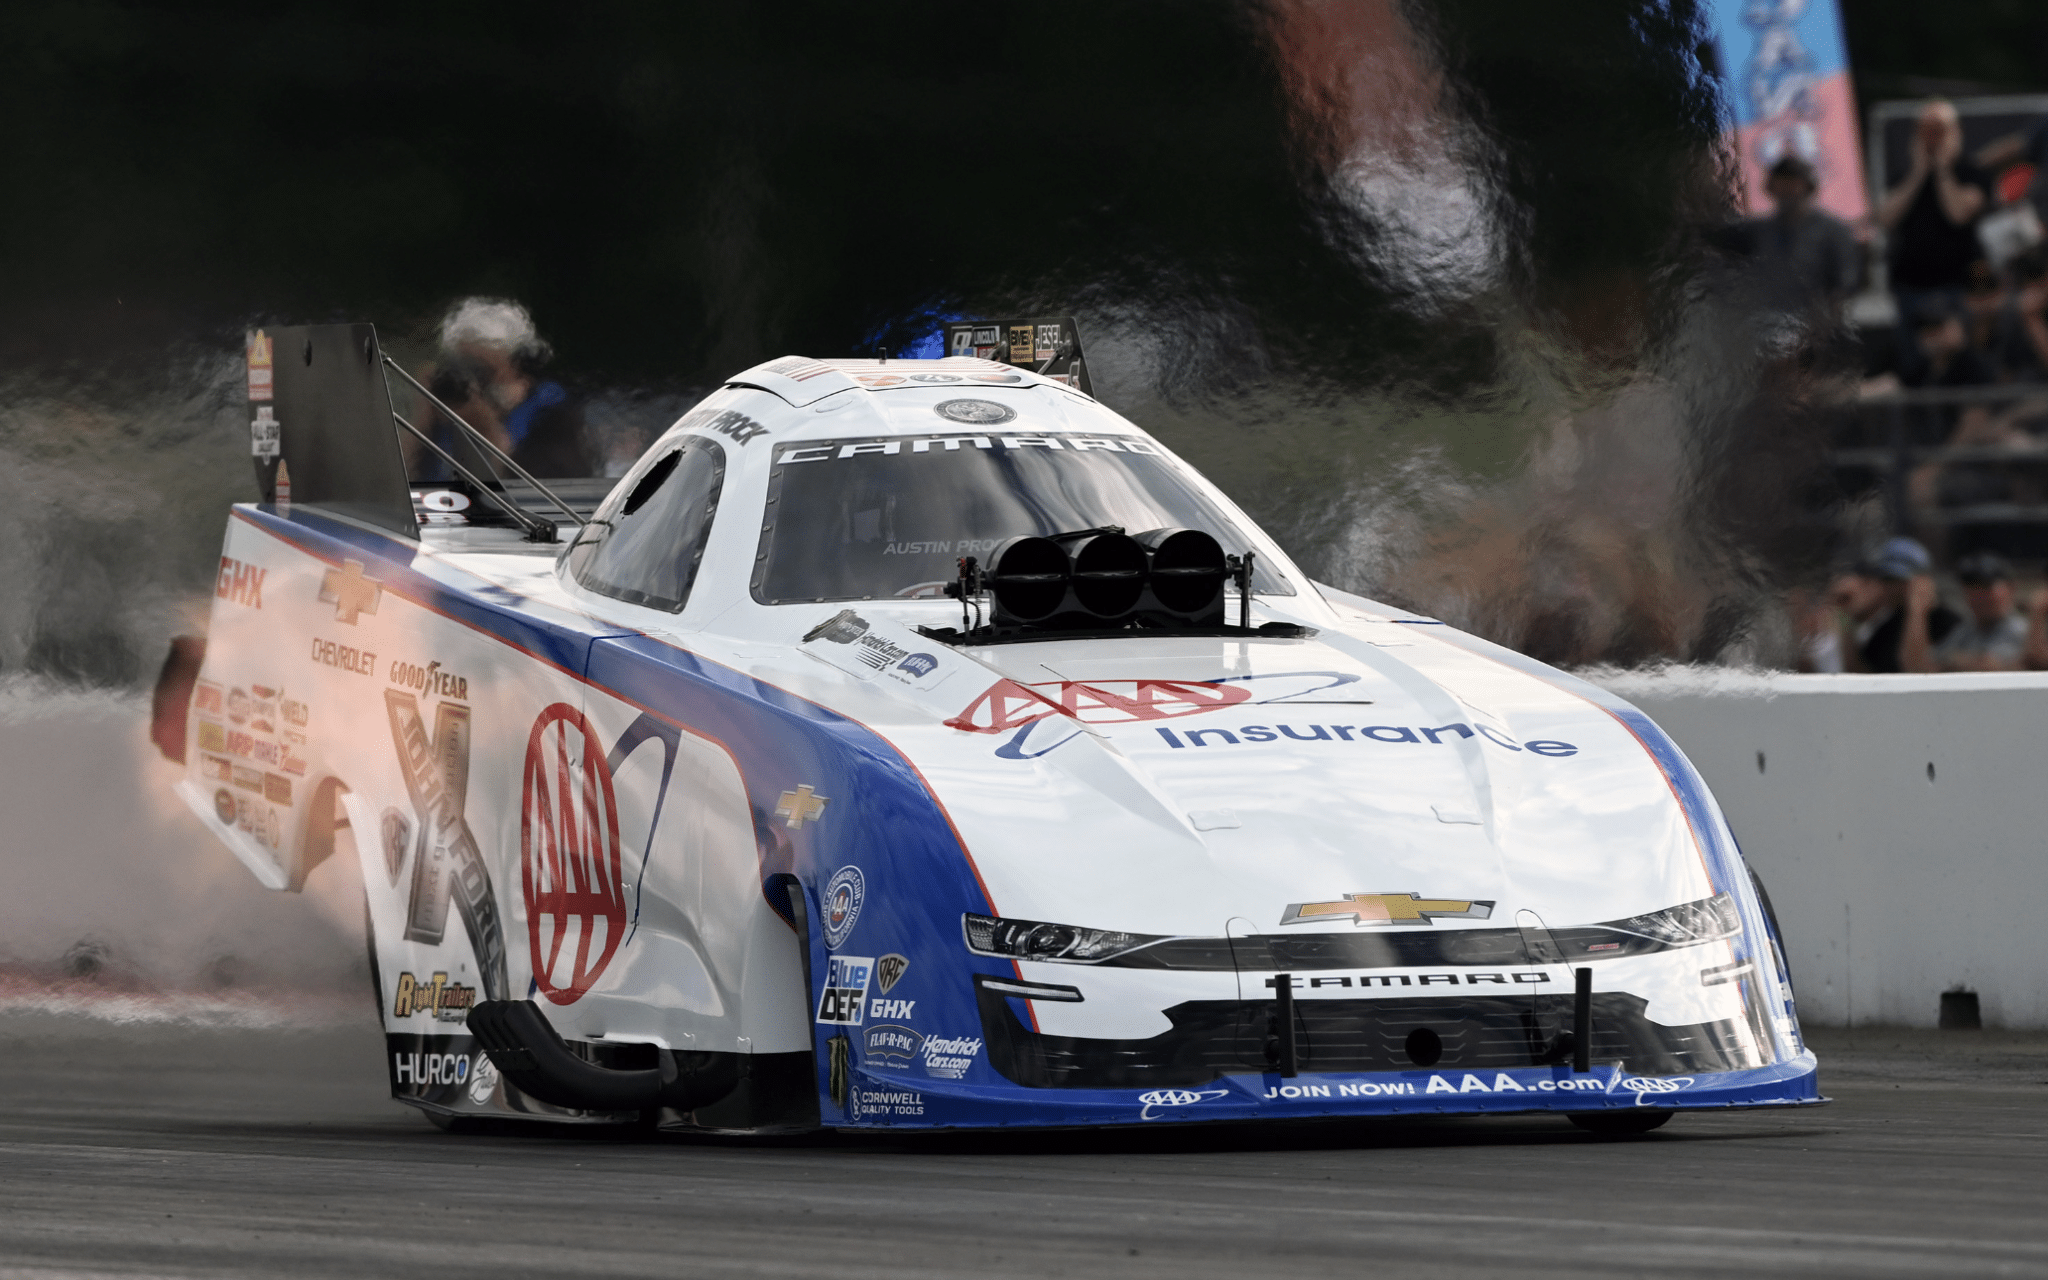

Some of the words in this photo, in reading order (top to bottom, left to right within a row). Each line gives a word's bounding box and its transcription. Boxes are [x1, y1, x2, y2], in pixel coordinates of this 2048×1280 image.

[777, 436, 1161, 464] CAMARO
[883, 542, 951, 555] AUSTIN
[217, 555, 268, 610] GHX
[312, 637, 377, 677] CHEVROLET
[944, 679, 1252, 734] AAA
[1155, 721, 1578, 758] Insurance
[819, 988, 864, 1022] DEF
[870, 999, 916, 1020] GHX
[921, 1034, 982, 1058] Hendrick
[395, 1052, 470, 1085] HURCO
[926, 1053, 972, 1070] Cars.com
[1264, 1084, 1331, 1100] JOIN
[1340, 1083, 1415, 1098] NOW!
[1425, 1073, 1605, 1095] AAA.com
[862, 1091, 924, 1105] CORNWELL
[862, 1104, 891, 1115] QUALITY
[894, 1105, 924, 1116] TOOLS
